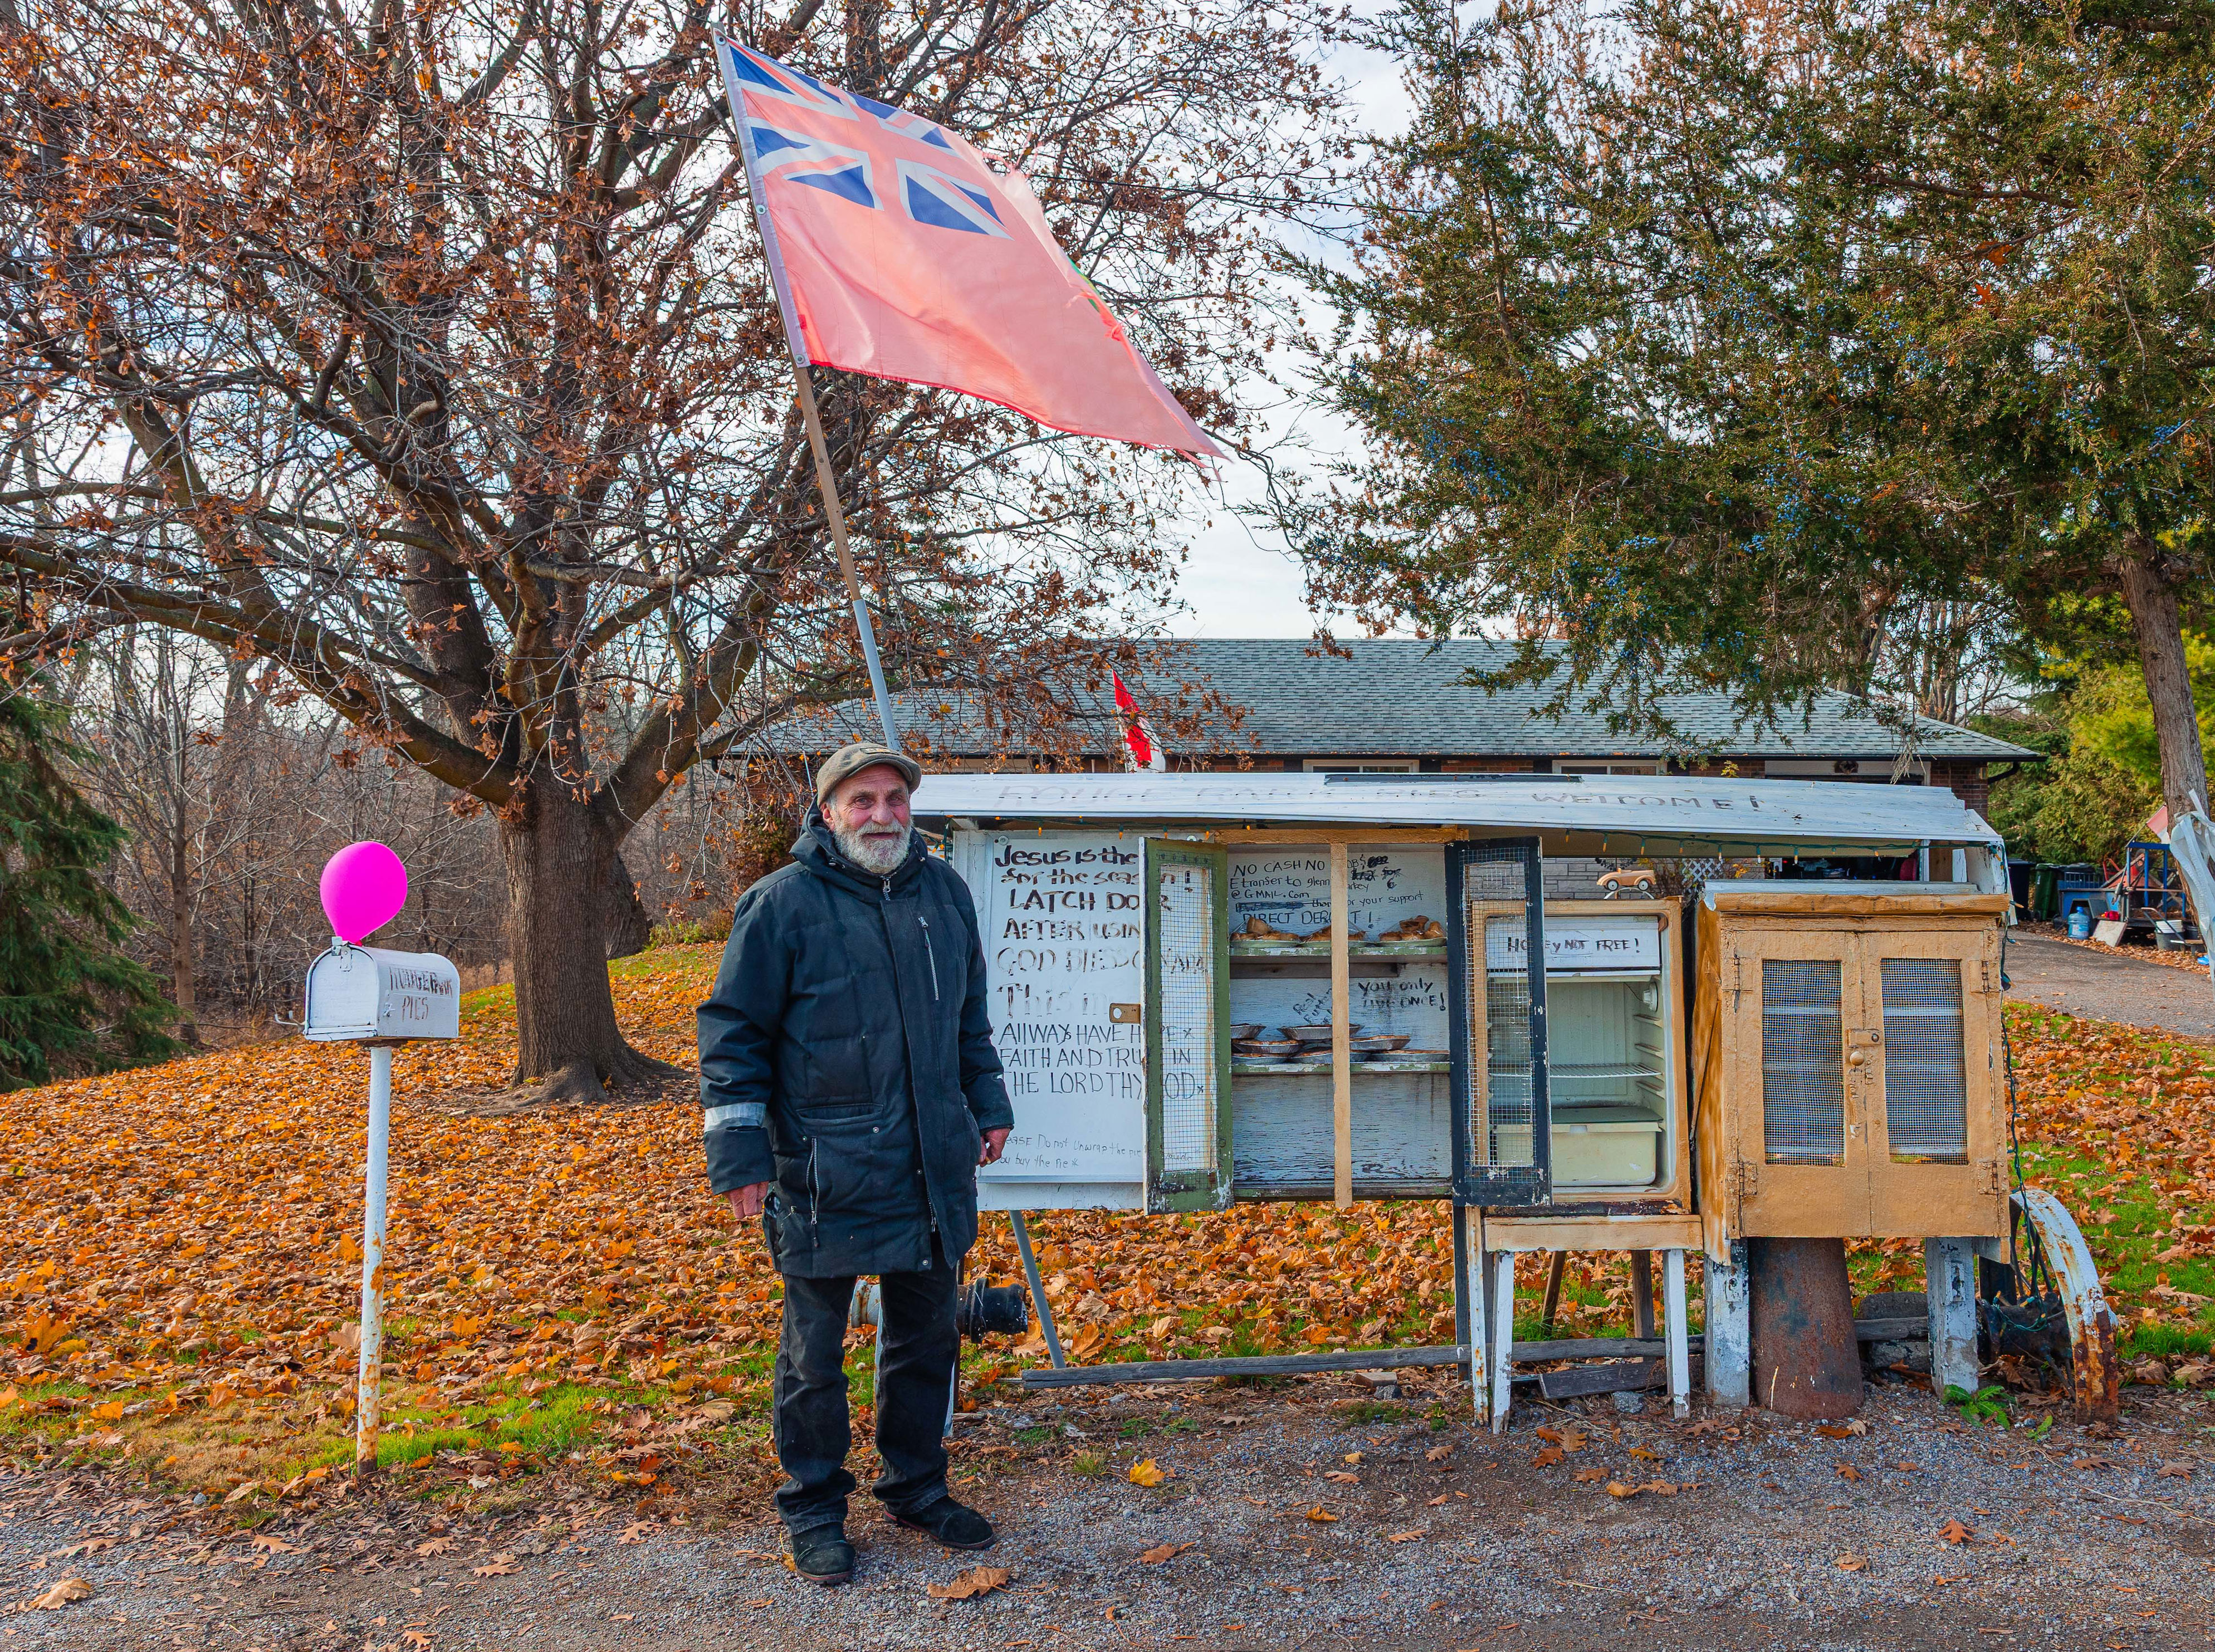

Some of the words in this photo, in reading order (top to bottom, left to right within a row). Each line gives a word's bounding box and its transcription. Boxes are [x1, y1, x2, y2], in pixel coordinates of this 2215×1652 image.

[995, 845, 1070, 867] Jesus
[1098, 845, 1138, 865] the
[1001, 867, 1044, 884] for
[1047, 868, 1088, 884] the
[1234, 864, 1257, 876] NO
[1264, 860, 1301, 873] CASH
[1305, 860, 1325, 871] NO
[1285, 876, 1302, 887] to
[1010, 888, 1096, 914] LATCH
[1106, 892, 1173, 912] DOR
[1360, 896, 1383, 907] your
[1388, 890, 1424, 905] support
[1003, 918, 1084, 940] AFTER
[1093, 921, 1141, 940] USIN
[1564, 940, 1589, 950] NOT
[997, 947, 1056, 976] GOD
[1076, 1023, 1125, 1045] HAVE
[1000, 1048, 1050, 1068] FAITH
[1057, 1048, 1102, 1068] AND
[1173, 1048, 1190, 1064] IN
[1052, 1072, 1103, 1094] LORD
[1106, 1072, 1142, 1100] THY
[1162, 1072, 1195, 1099] OD
[1054, 1137, 1068, 1148] not
[1110, 1142, 1125, 1155] the
[1129, 1148, 1141, 1158] pie
[1016, 1152, 1030, 1167] buy
[1034, 1155, 1050, 1167] the
